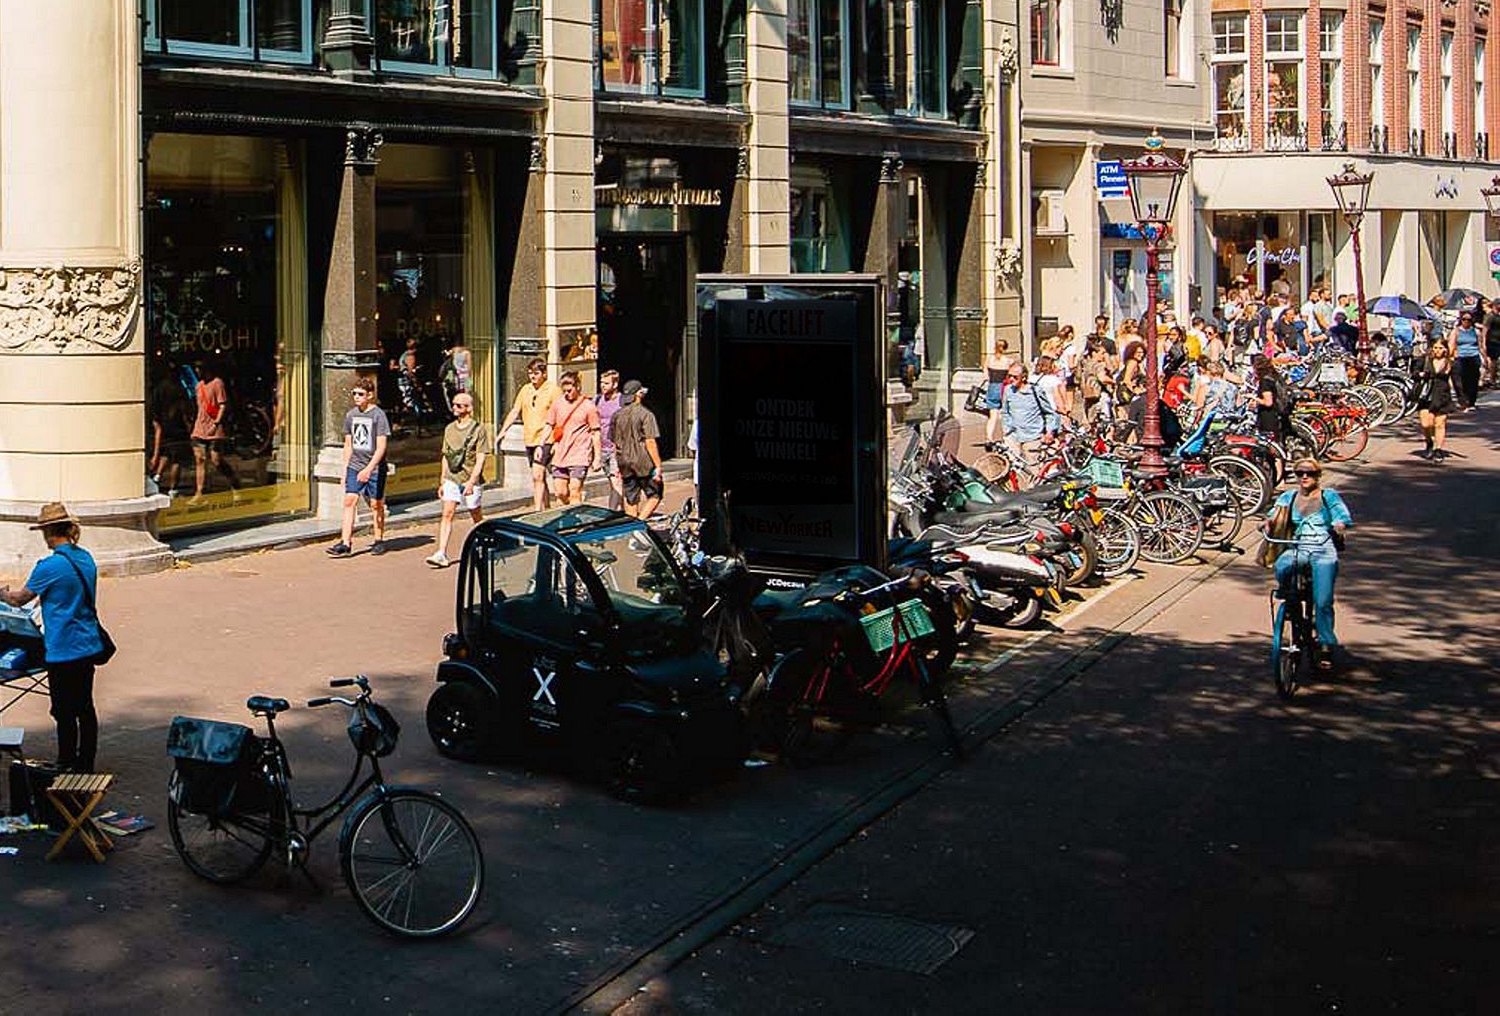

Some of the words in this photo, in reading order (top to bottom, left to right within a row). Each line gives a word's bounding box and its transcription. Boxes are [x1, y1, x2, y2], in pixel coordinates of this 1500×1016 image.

[1100, 166, 1118, 174] ATM
[747, 309, 825, 336] FACELIFT
[181, 328, 259, 351] ROUHI
[756, 398, 817, 418] ONTDEK
[734, 419, 775, 437] ONZE
[777, 420, 839, 440] NIEUWE
[766, 578, 805, 588] JCDecau
[531, 667, 556, 705] X
